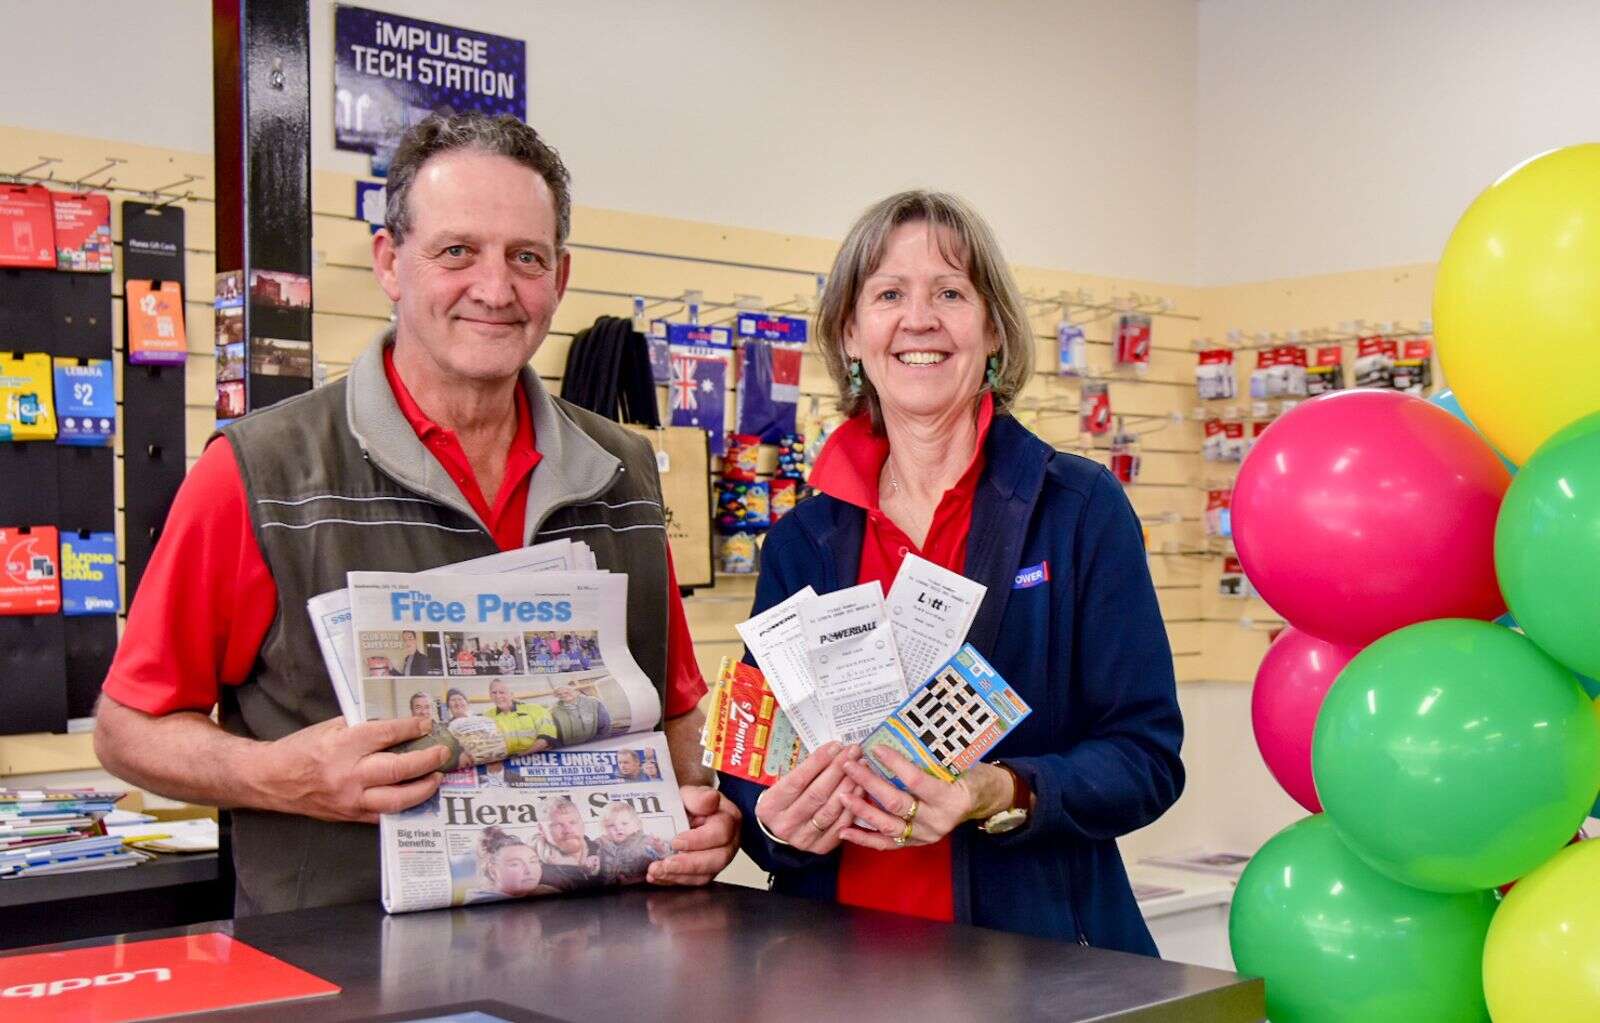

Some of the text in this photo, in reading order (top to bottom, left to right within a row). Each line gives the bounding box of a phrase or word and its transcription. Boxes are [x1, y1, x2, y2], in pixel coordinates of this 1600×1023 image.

[375, 20, 488, 65] iMPULSE
[350, 44, 514, 100] TECH STATION
[73, 382, 94, 406] $2
[1014, 570, 1043, 585] OWER
[390, 591, 573, 623] Free Press
[409, 590, 432, 601] The
[818, 620, 878, 645] POWERBALL
[729, 719, 750, 767] Tripling
[510, 751, 618, 767] NOBLE UNREST
[526, 766, 606, 776] WHY HE HAD TO GO
[444, 796, 573, 826] Hera
[397, 828, 442, 839] Big rise in
[397, 839, 436, 848] benefits
[0, 967, 172, 998] Ladb
